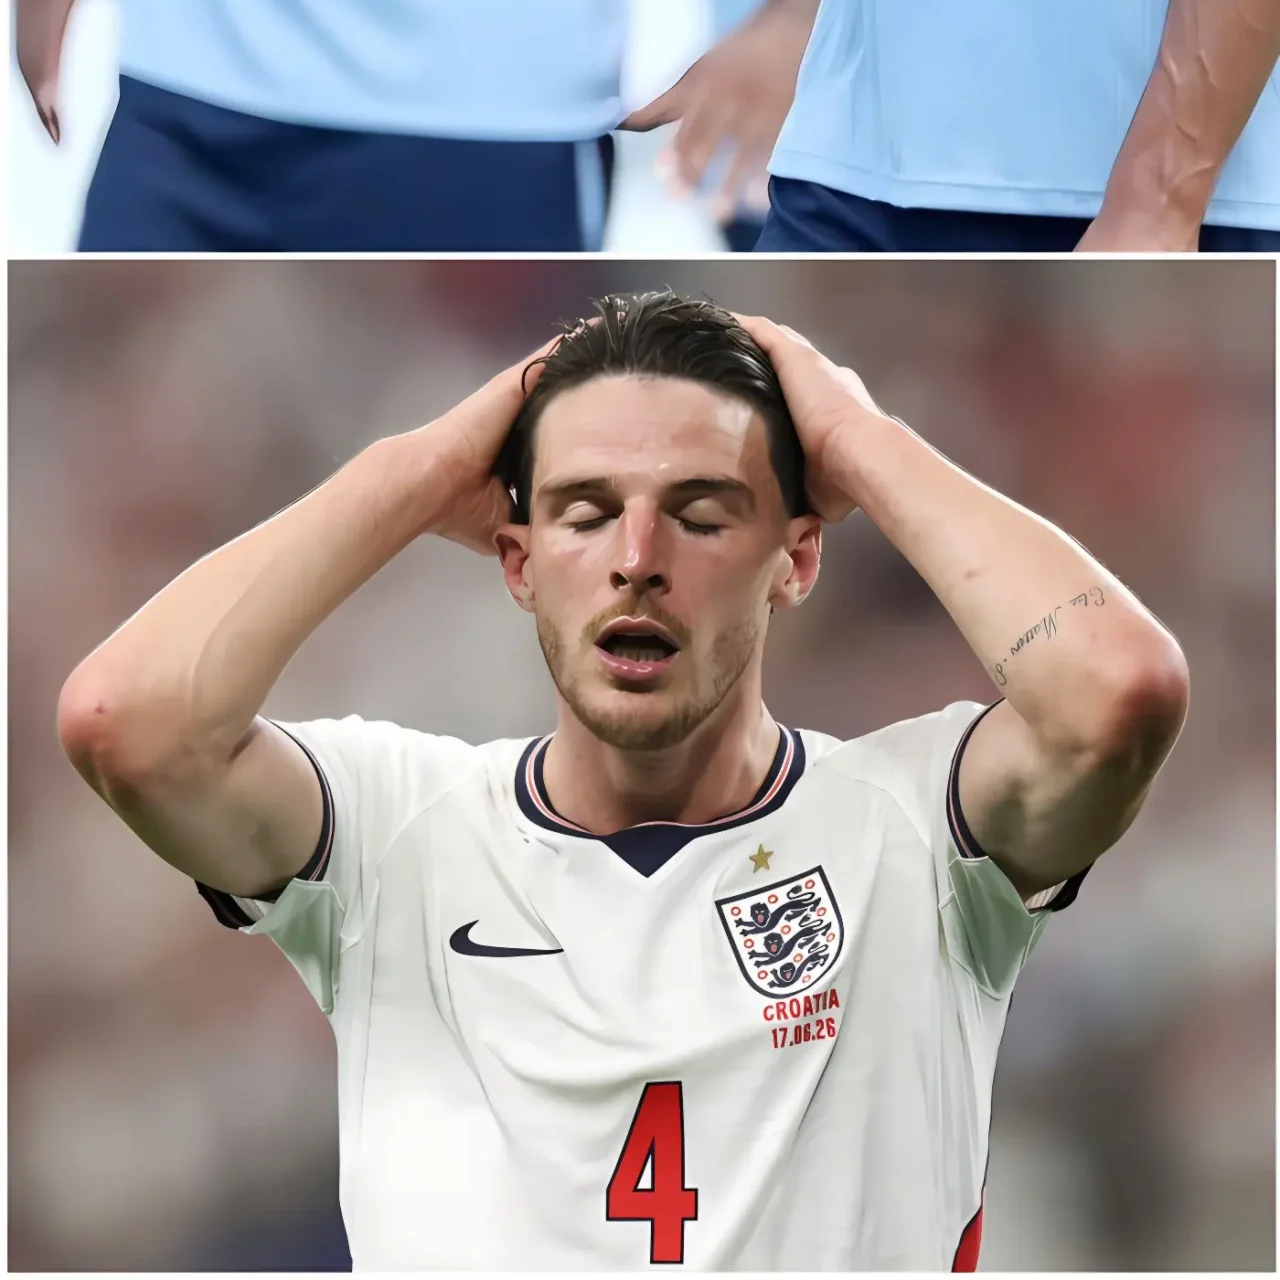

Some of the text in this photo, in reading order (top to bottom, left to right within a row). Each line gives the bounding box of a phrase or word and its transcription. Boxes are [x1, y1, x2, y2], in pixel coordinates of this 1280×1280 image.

[763, 988, 840, 1021] CROATIA
[771, 1017, 837, 1049] 17.06.26
[605, 1080, 699, 1265] 4
